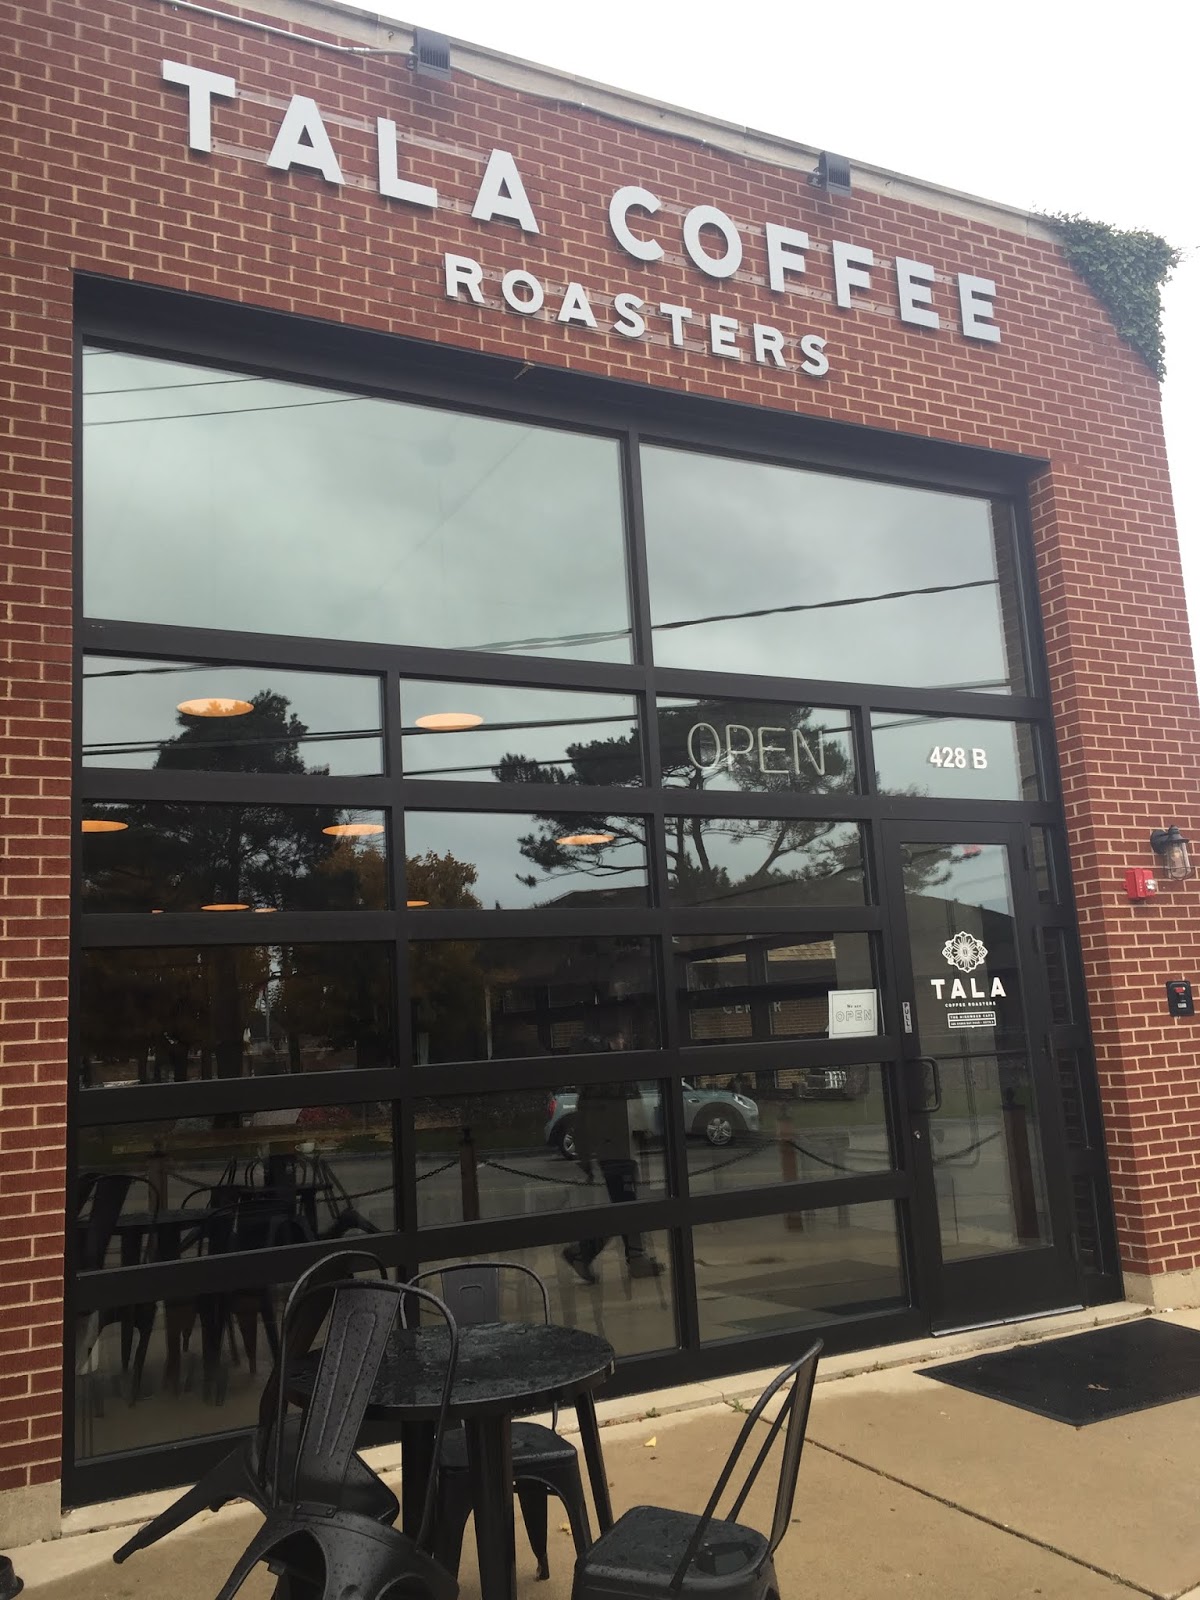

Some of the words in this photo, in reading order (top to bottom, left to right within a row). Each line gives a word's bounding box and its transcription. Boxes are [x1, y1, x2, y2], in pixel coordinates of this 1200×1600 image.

[162, 59, 540, 234] TALA
[609, 185, 1001, 343] COFFEE
[444, 252, 830, 376] ROASTERS
[687, 722, 825, 776] OPEN
[929, 746, 966, 769] 428
[972, 748, 988, 769] B
[930, 976, 1007, 1000] TALA
[835, 1008, 873, 1022] OPEN
